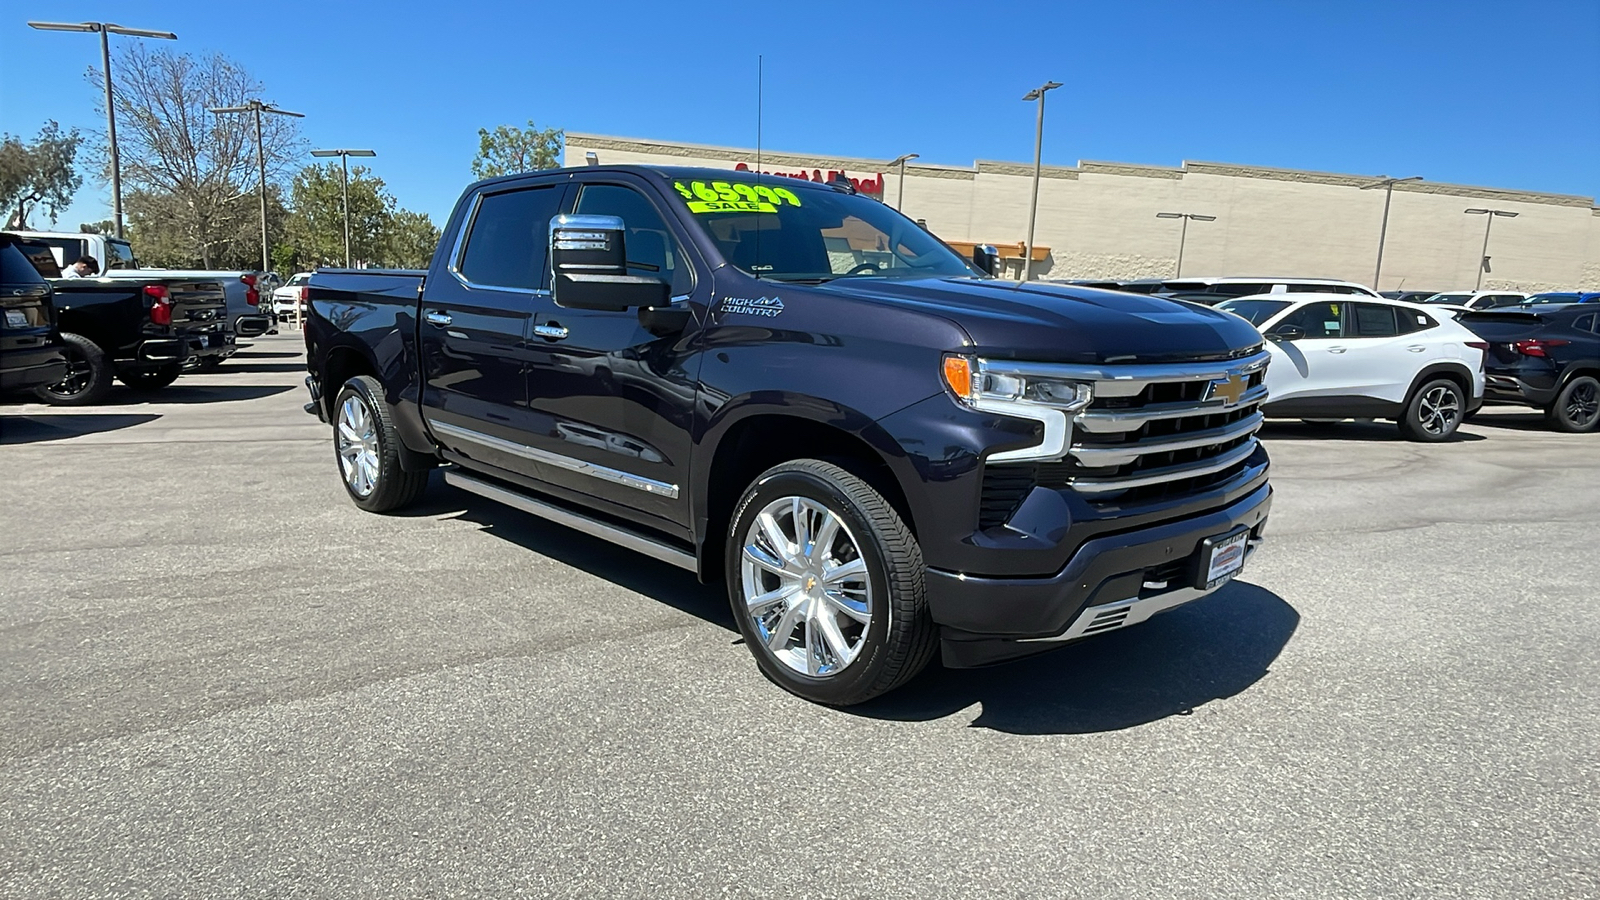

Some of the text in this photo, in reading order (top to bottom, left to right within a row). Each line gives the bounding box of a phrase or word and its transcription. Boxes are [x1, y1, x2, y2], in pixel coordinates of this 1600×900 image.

[828, 170, 884, 195] Fnal
[704, 202, 760, 211] SALE
[723, 296, 754, 306] HIGH
[720, 304, 783, 317] COUNTRY
